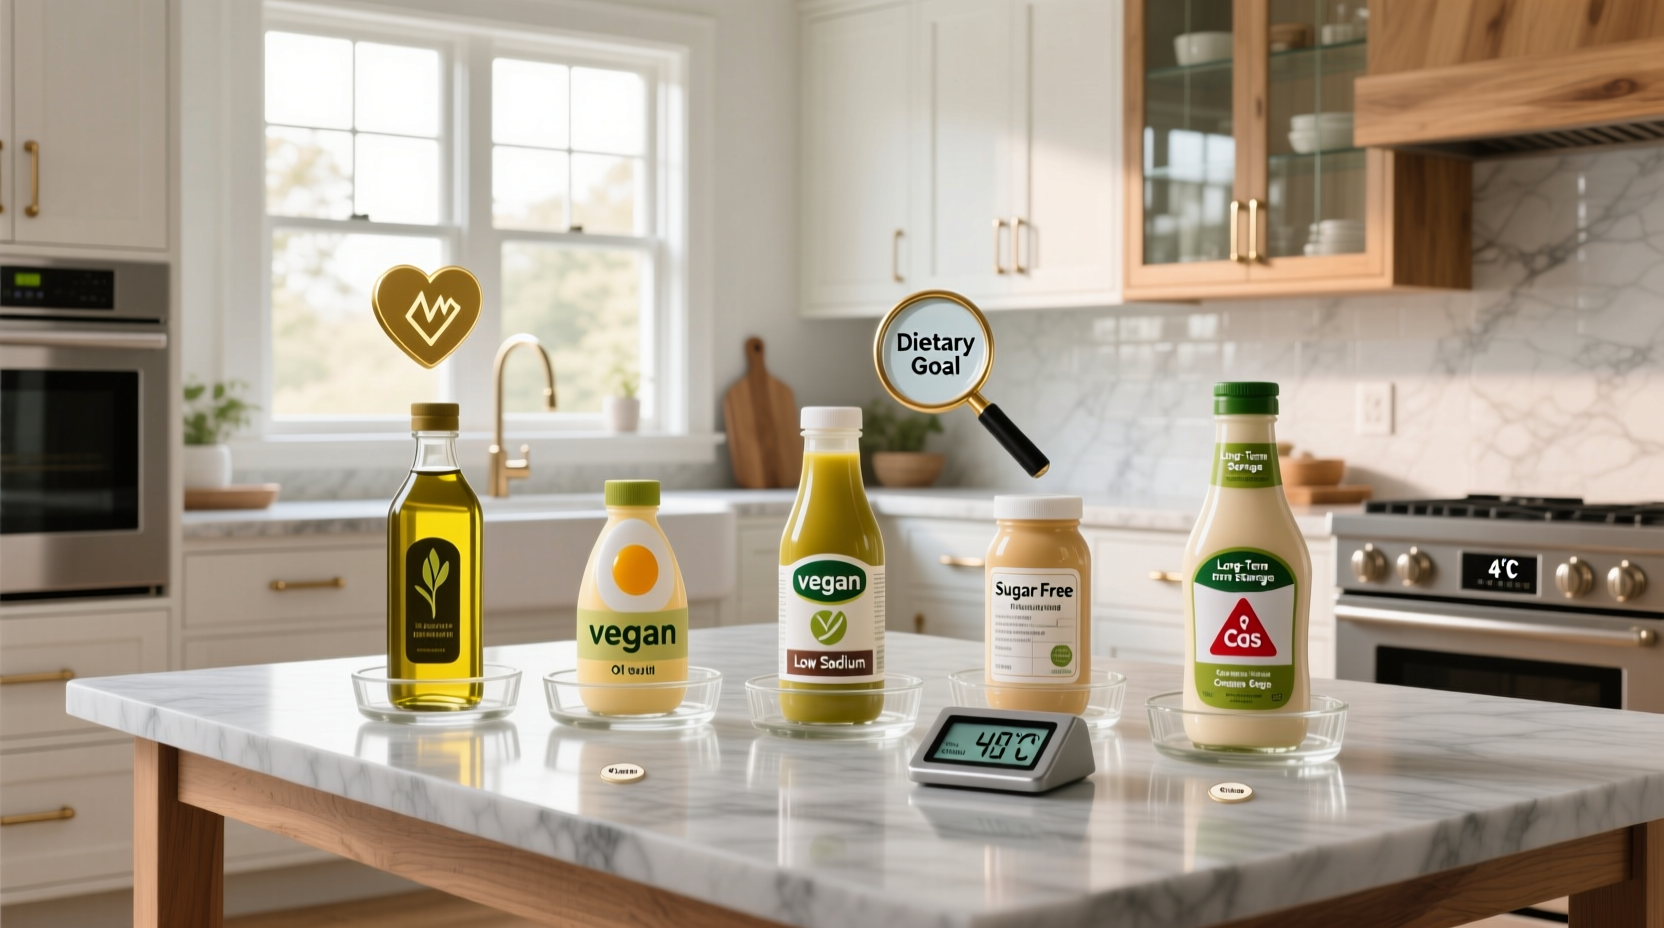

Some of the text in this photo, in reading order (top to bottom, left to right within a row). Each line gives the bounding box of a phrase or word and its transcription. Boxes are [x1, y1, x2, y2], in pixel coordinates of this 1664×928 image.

[897, 332, 975, 357] Dietary
[911, 355, 960, 375] Goal
[797, 574, 861, 595] vegan
[995, 581, 1074, 601] Sugar Free
[589, 624, 676, 653] vegan
[794, 654, 817, 670] Low
